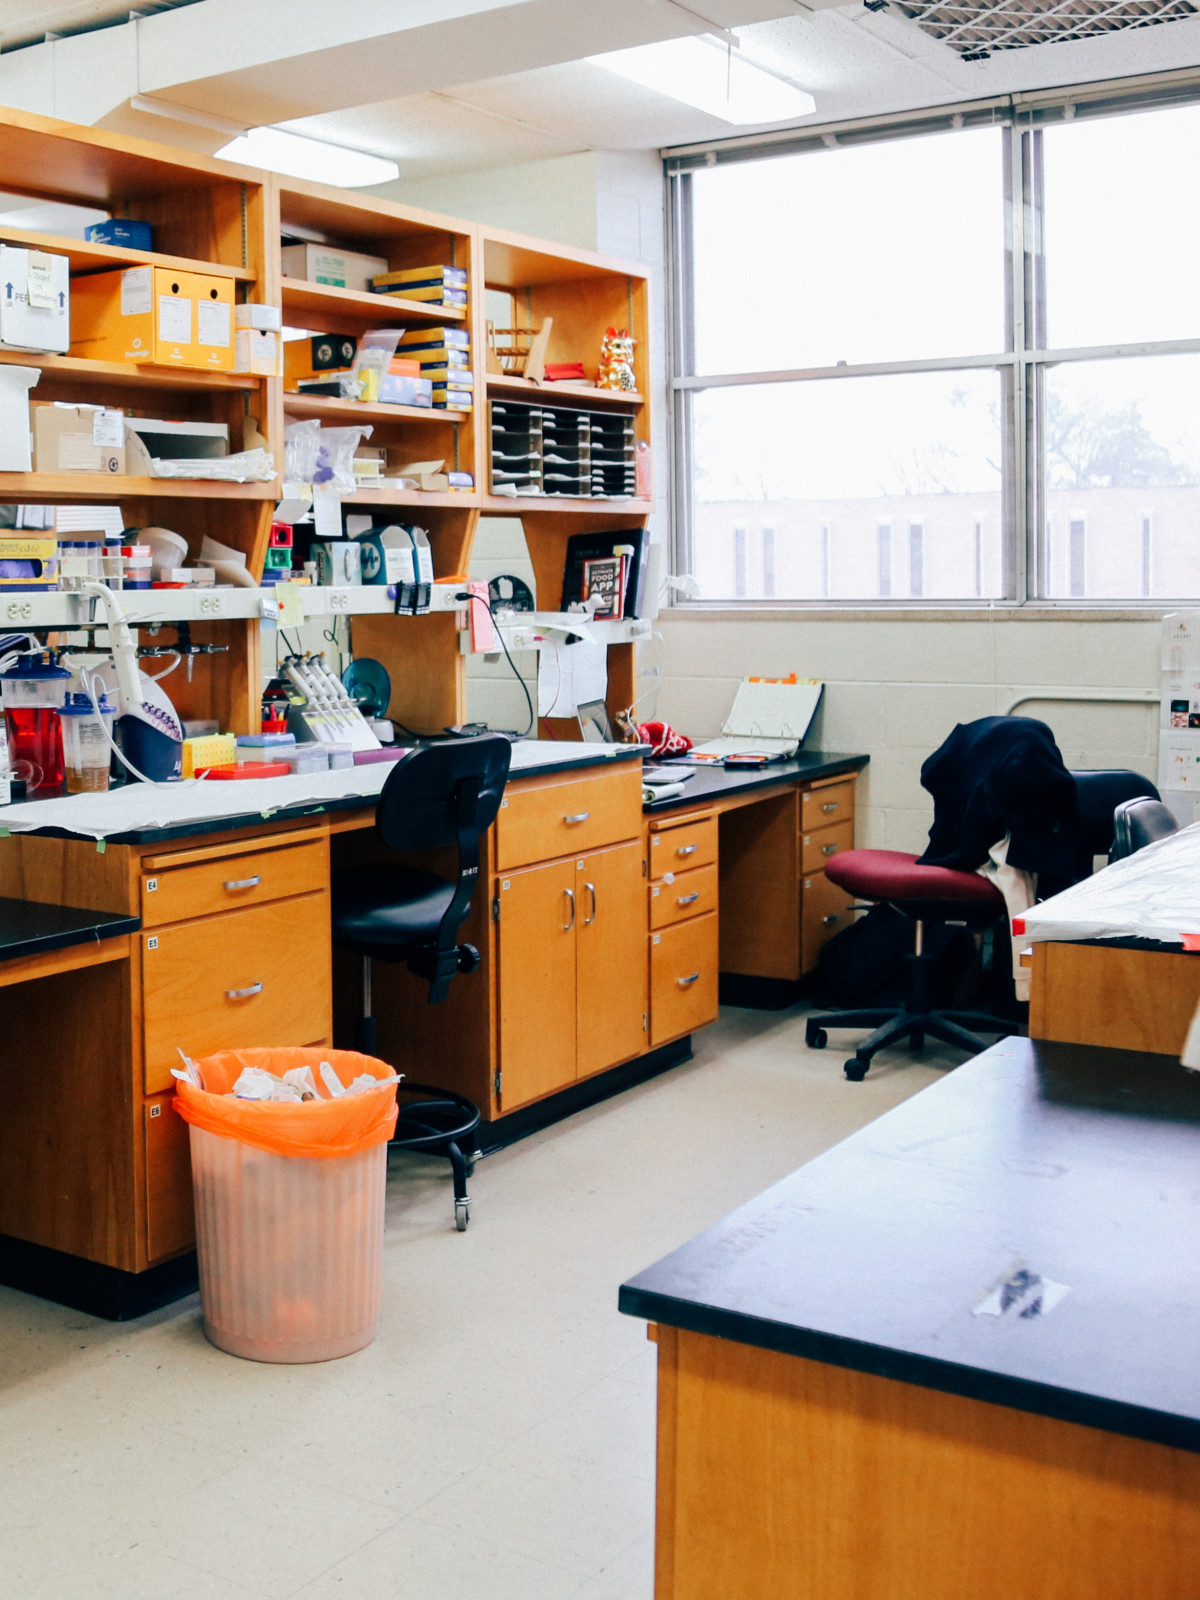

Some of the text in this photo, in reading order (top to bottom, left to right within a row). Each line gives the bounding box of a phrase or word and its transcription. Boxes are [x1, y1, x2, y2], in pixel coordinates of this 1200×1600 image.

[591, 574, 614, 582] FOOD
[590, 581, 614, 592] APP
[148, 881, 157, 890] E4
[149, 939, 157, 948] E5
[151, 1106, 160, 1116] E6
